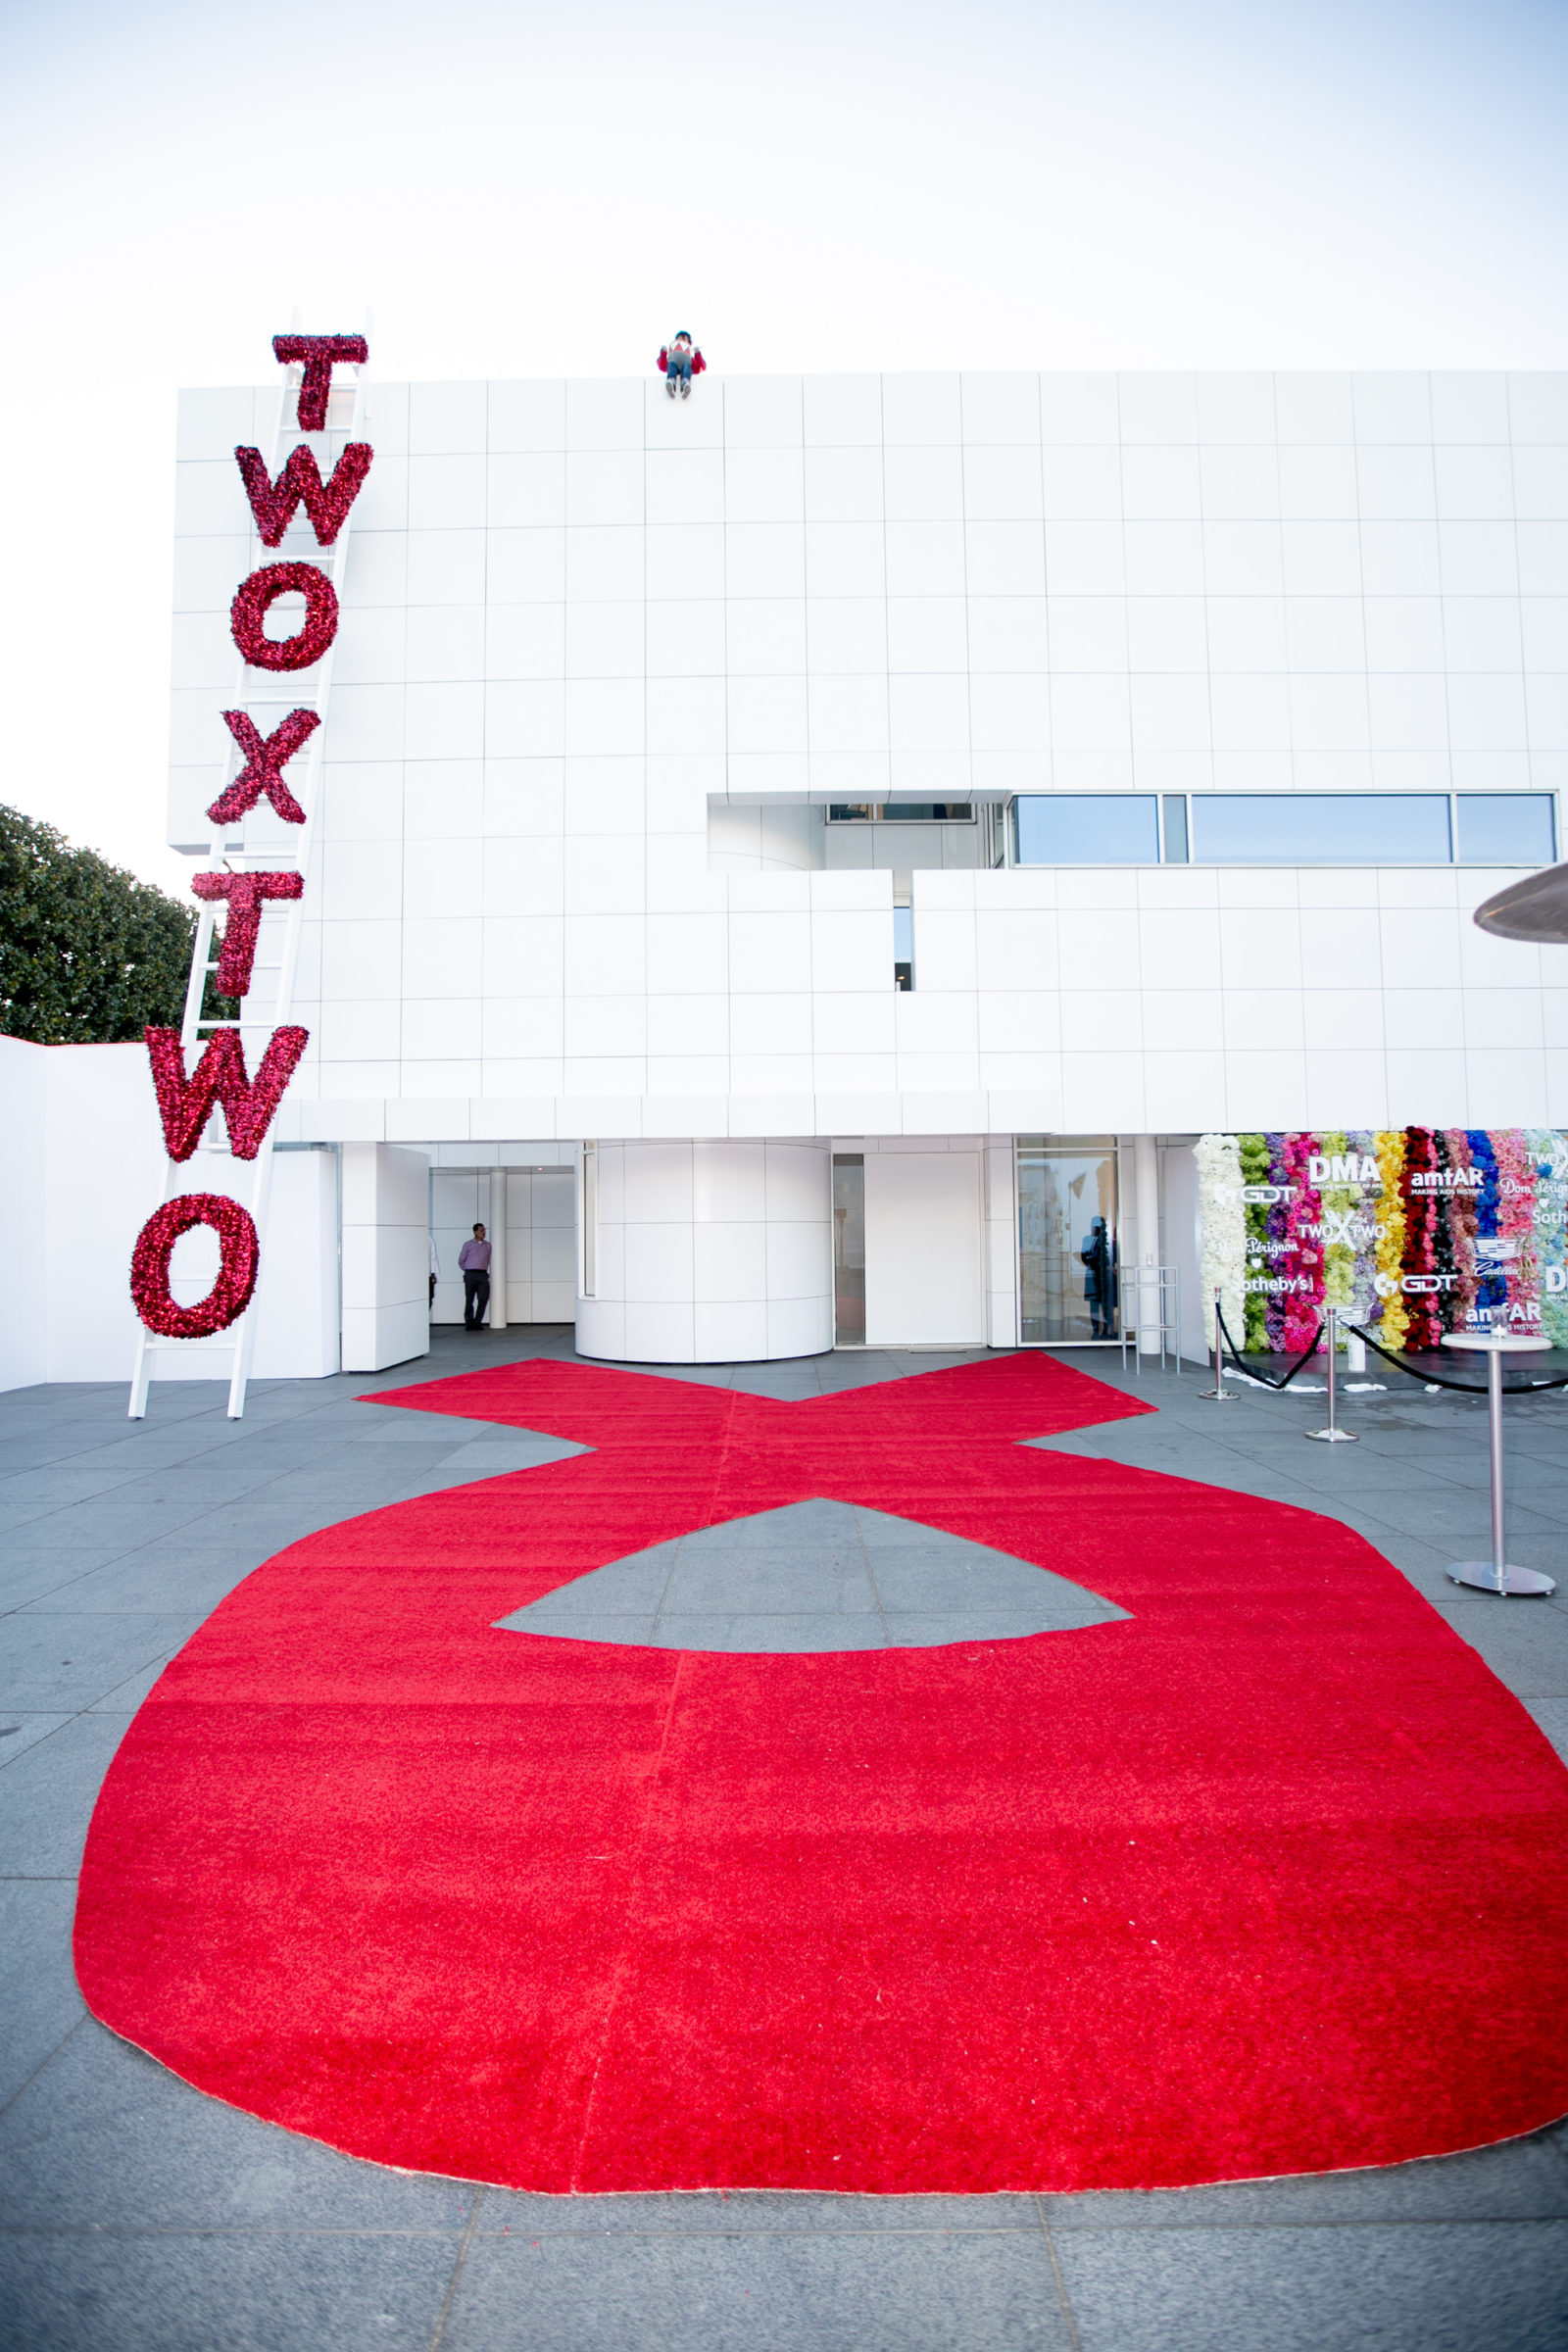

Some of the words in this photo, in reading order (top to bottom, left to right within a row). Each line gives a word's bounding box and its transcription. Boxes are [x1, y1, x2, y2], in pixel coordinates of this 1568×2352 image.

[1525, 1152, 1560, 1166] TWO
[1308, 1155, 1382, 1183] DMA
[1411, 1166, 1485, 1187] amfAR
[1498, 1177, 1532, 1194] Dom
[1242, 1186, 1297, 1203] GDT
[1298, 1224, 1334, 1239] TWO
[1348, 1225, 1386, 1239] TWO
[1246, 1237, 1298, 1258] Pérignon
[1401, 1275, 1458, 1293] GDT
